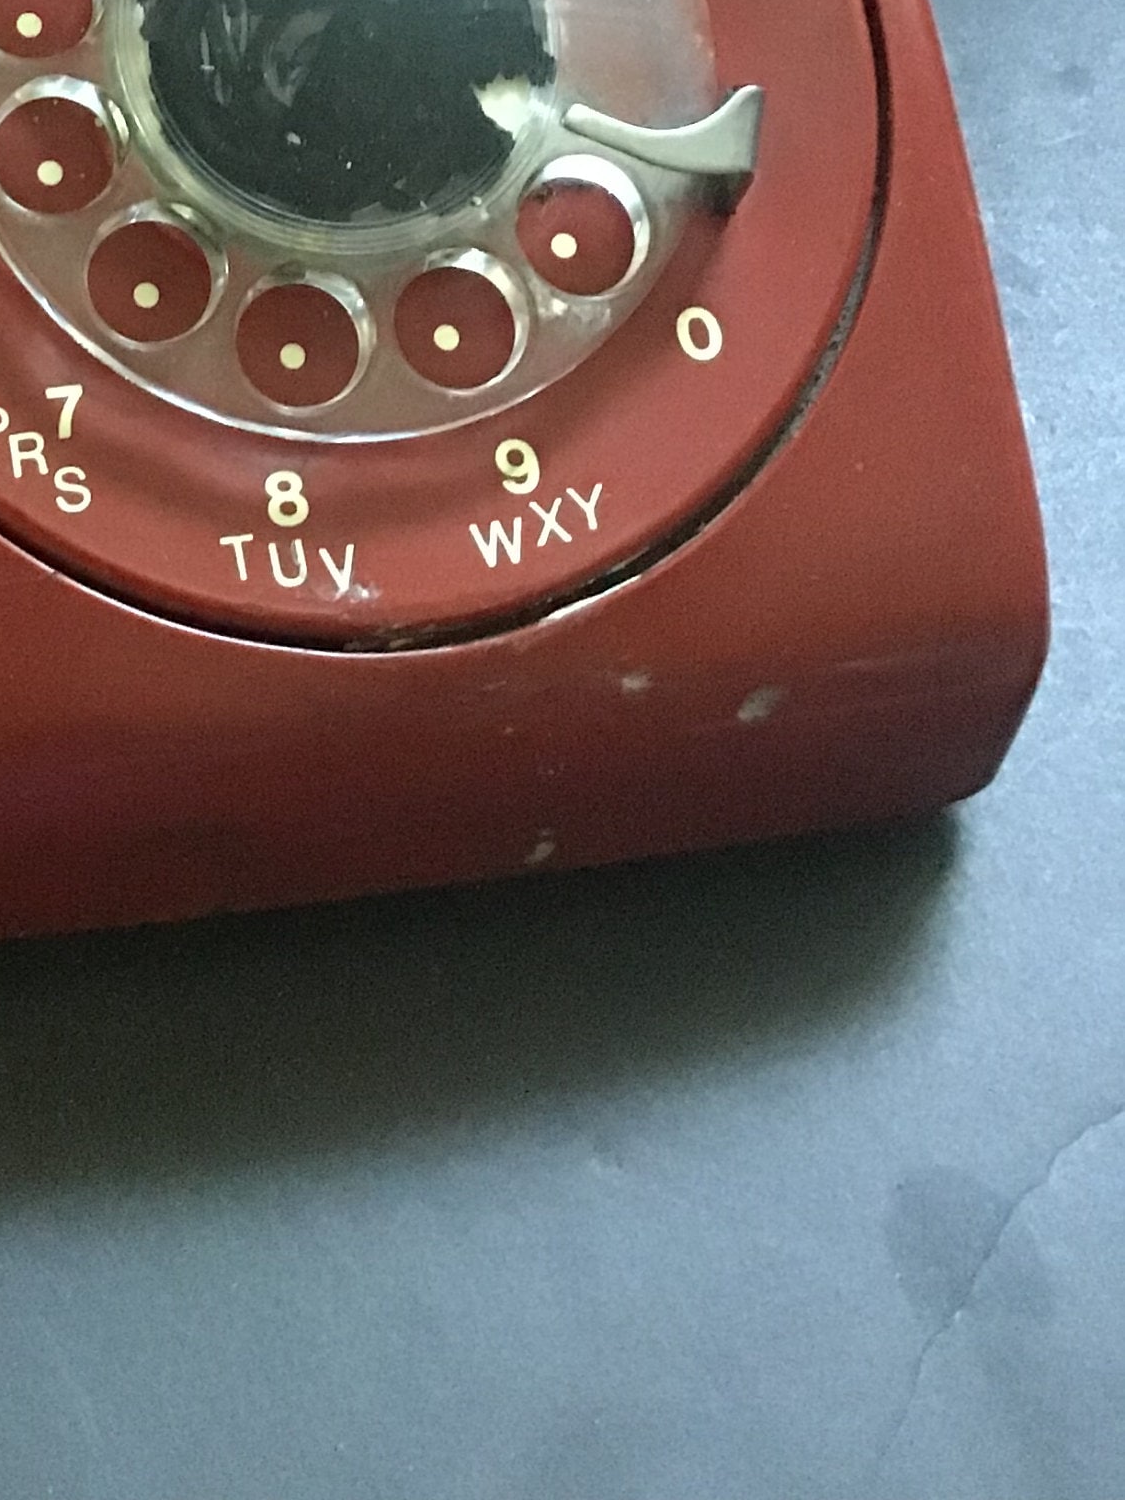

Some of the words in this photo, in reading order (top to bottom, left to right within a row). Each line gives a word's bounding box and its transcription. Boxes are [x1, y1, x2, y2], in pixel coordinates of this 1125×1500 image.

[44, 383, 84, 439] 7
[494, 438, 541, 496] 9
[264, 469, 310, 528] 8
[468, 482, 604, 569] WXY
[219, 533, 356, 596] TUV
